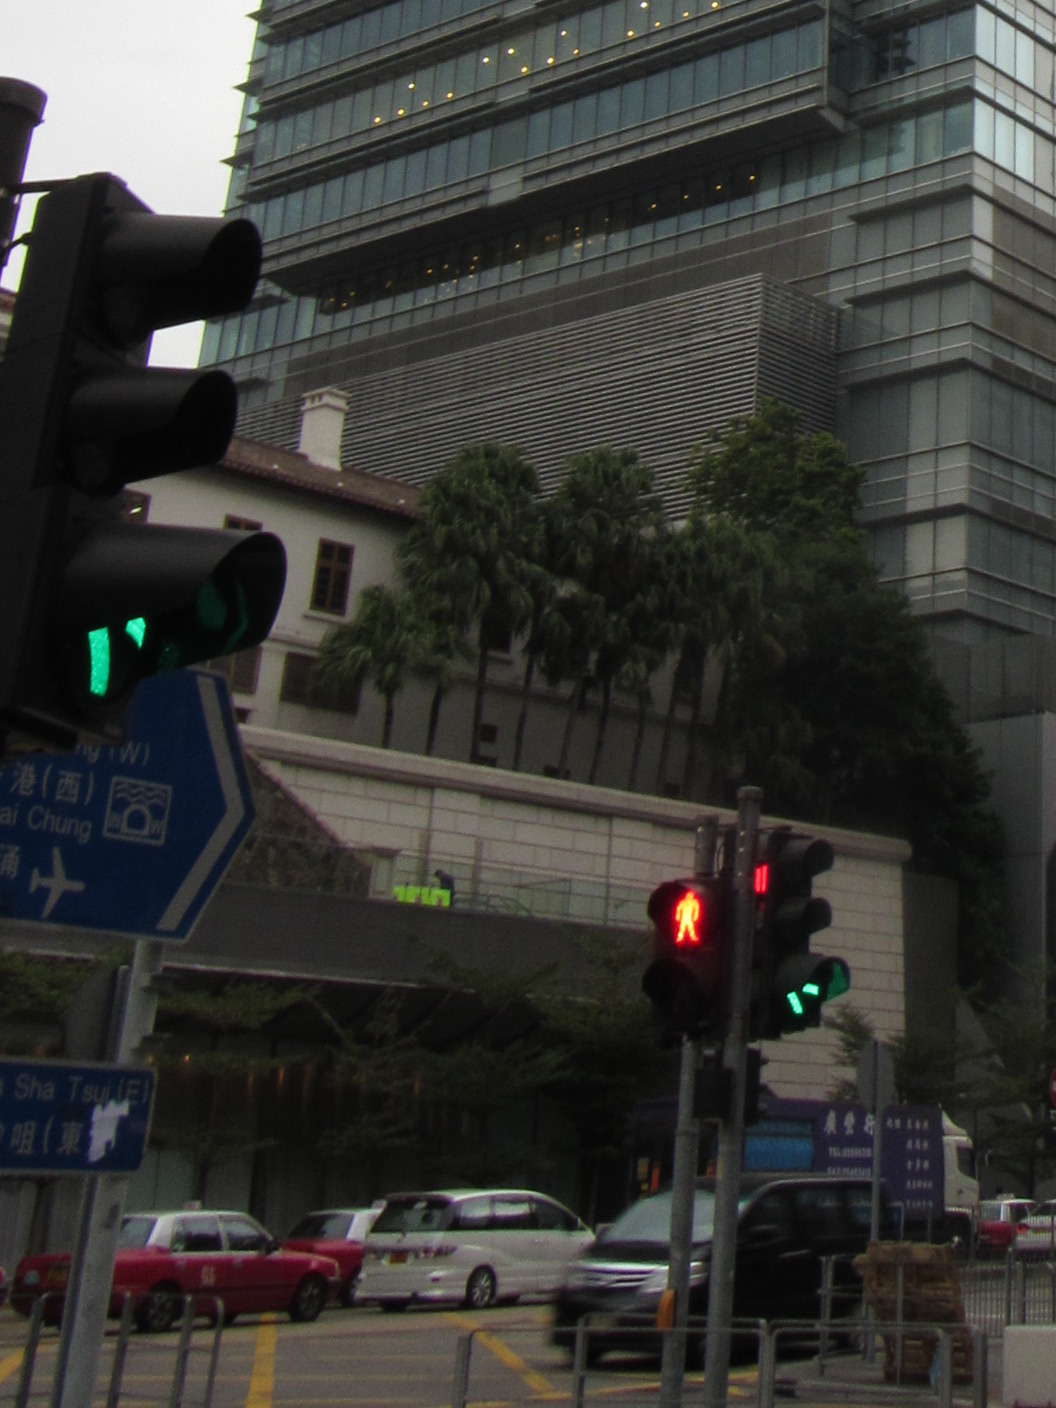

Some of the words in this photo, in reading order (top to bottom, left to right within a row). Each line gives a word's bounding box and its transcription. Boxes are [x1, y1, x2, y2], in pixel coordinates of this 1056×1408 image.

[0, 760, 94, 806] 港(西)
[27, 805, 92, 845] Chung
[14, 1072, 55, 1100] Sha
